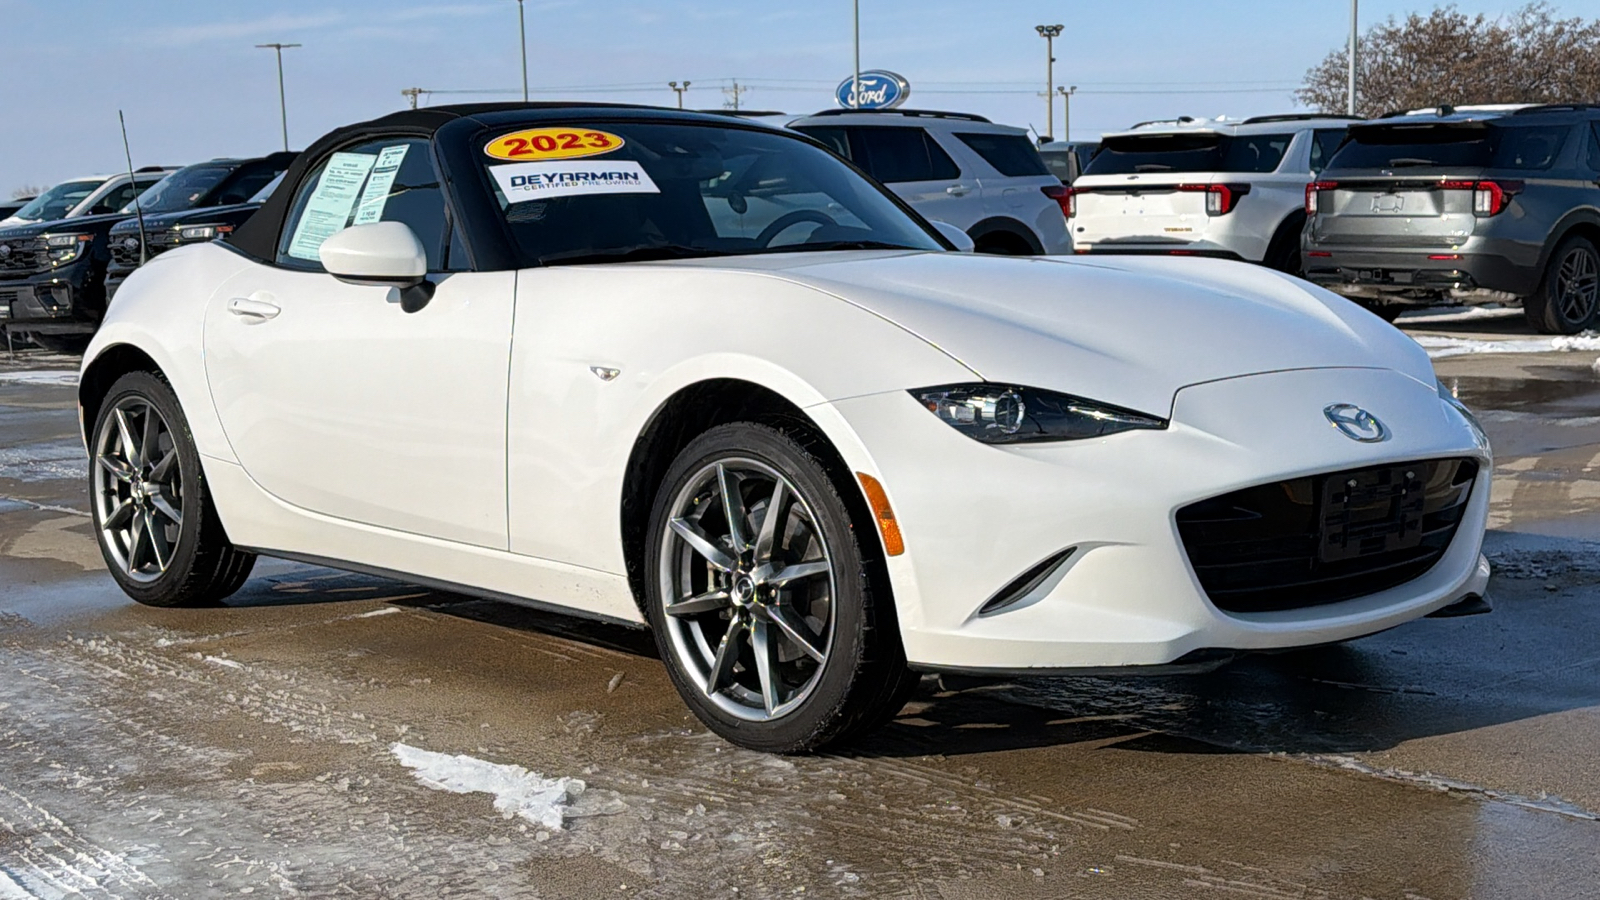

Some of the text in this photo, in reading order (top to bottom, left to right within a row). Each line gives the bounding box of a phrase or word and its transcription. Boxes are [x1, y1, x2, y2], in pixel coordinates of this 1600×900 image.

[847, 79, 887, 105] Ford
[503, 132, 612, 156] 2023
[510, 171, 640, 187] DEYARMAN
[523, 179, 642, 191] CERTIFIED PRE-OWNED
